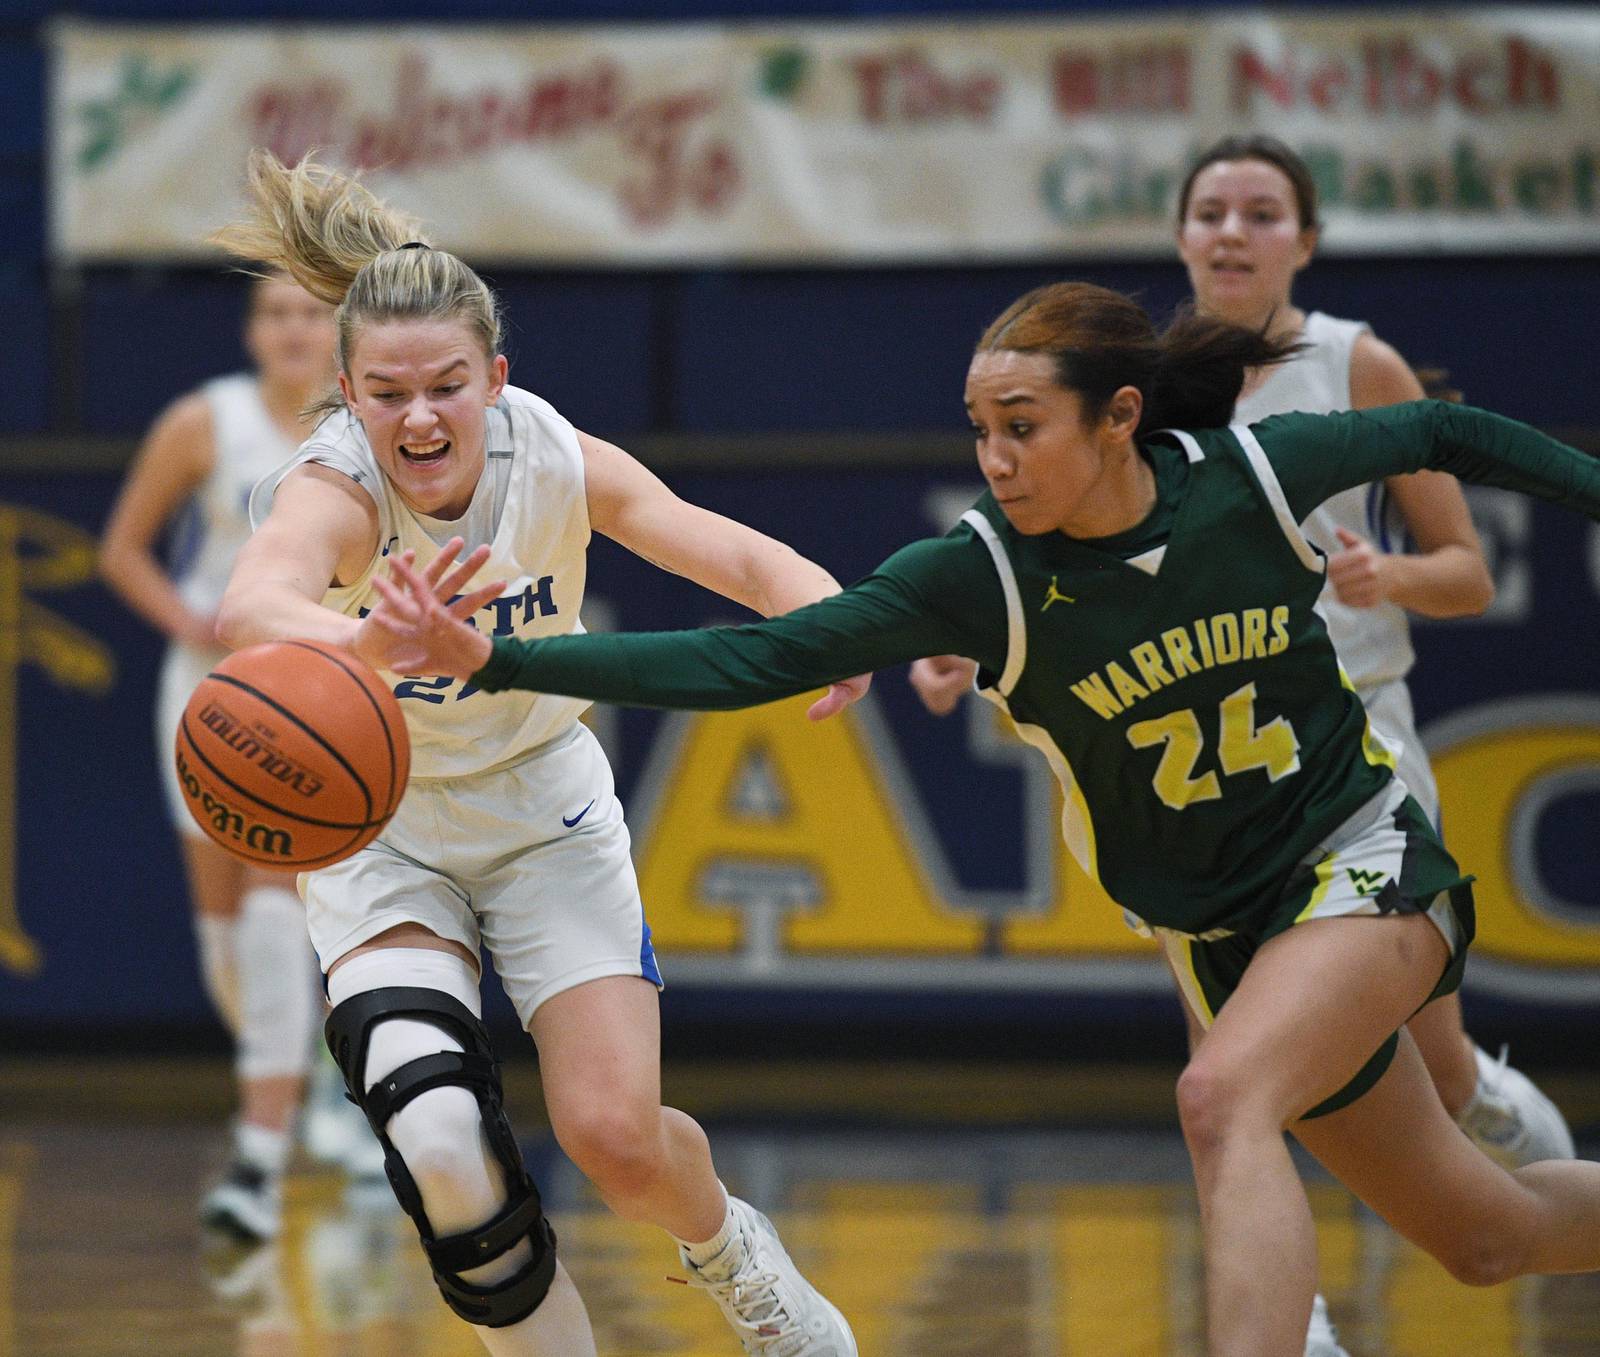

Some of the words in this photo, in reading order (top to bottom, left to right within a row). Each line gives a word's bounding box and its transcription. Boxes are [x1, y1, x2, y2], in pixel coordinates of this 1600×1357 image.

[1069, 605, 1291, 721] WARRIORS
[199, 703, 325, 797] EVOLUTION
[1126, 681, 1302, 811] 24
[176, 751, 294, 857] Wilson
